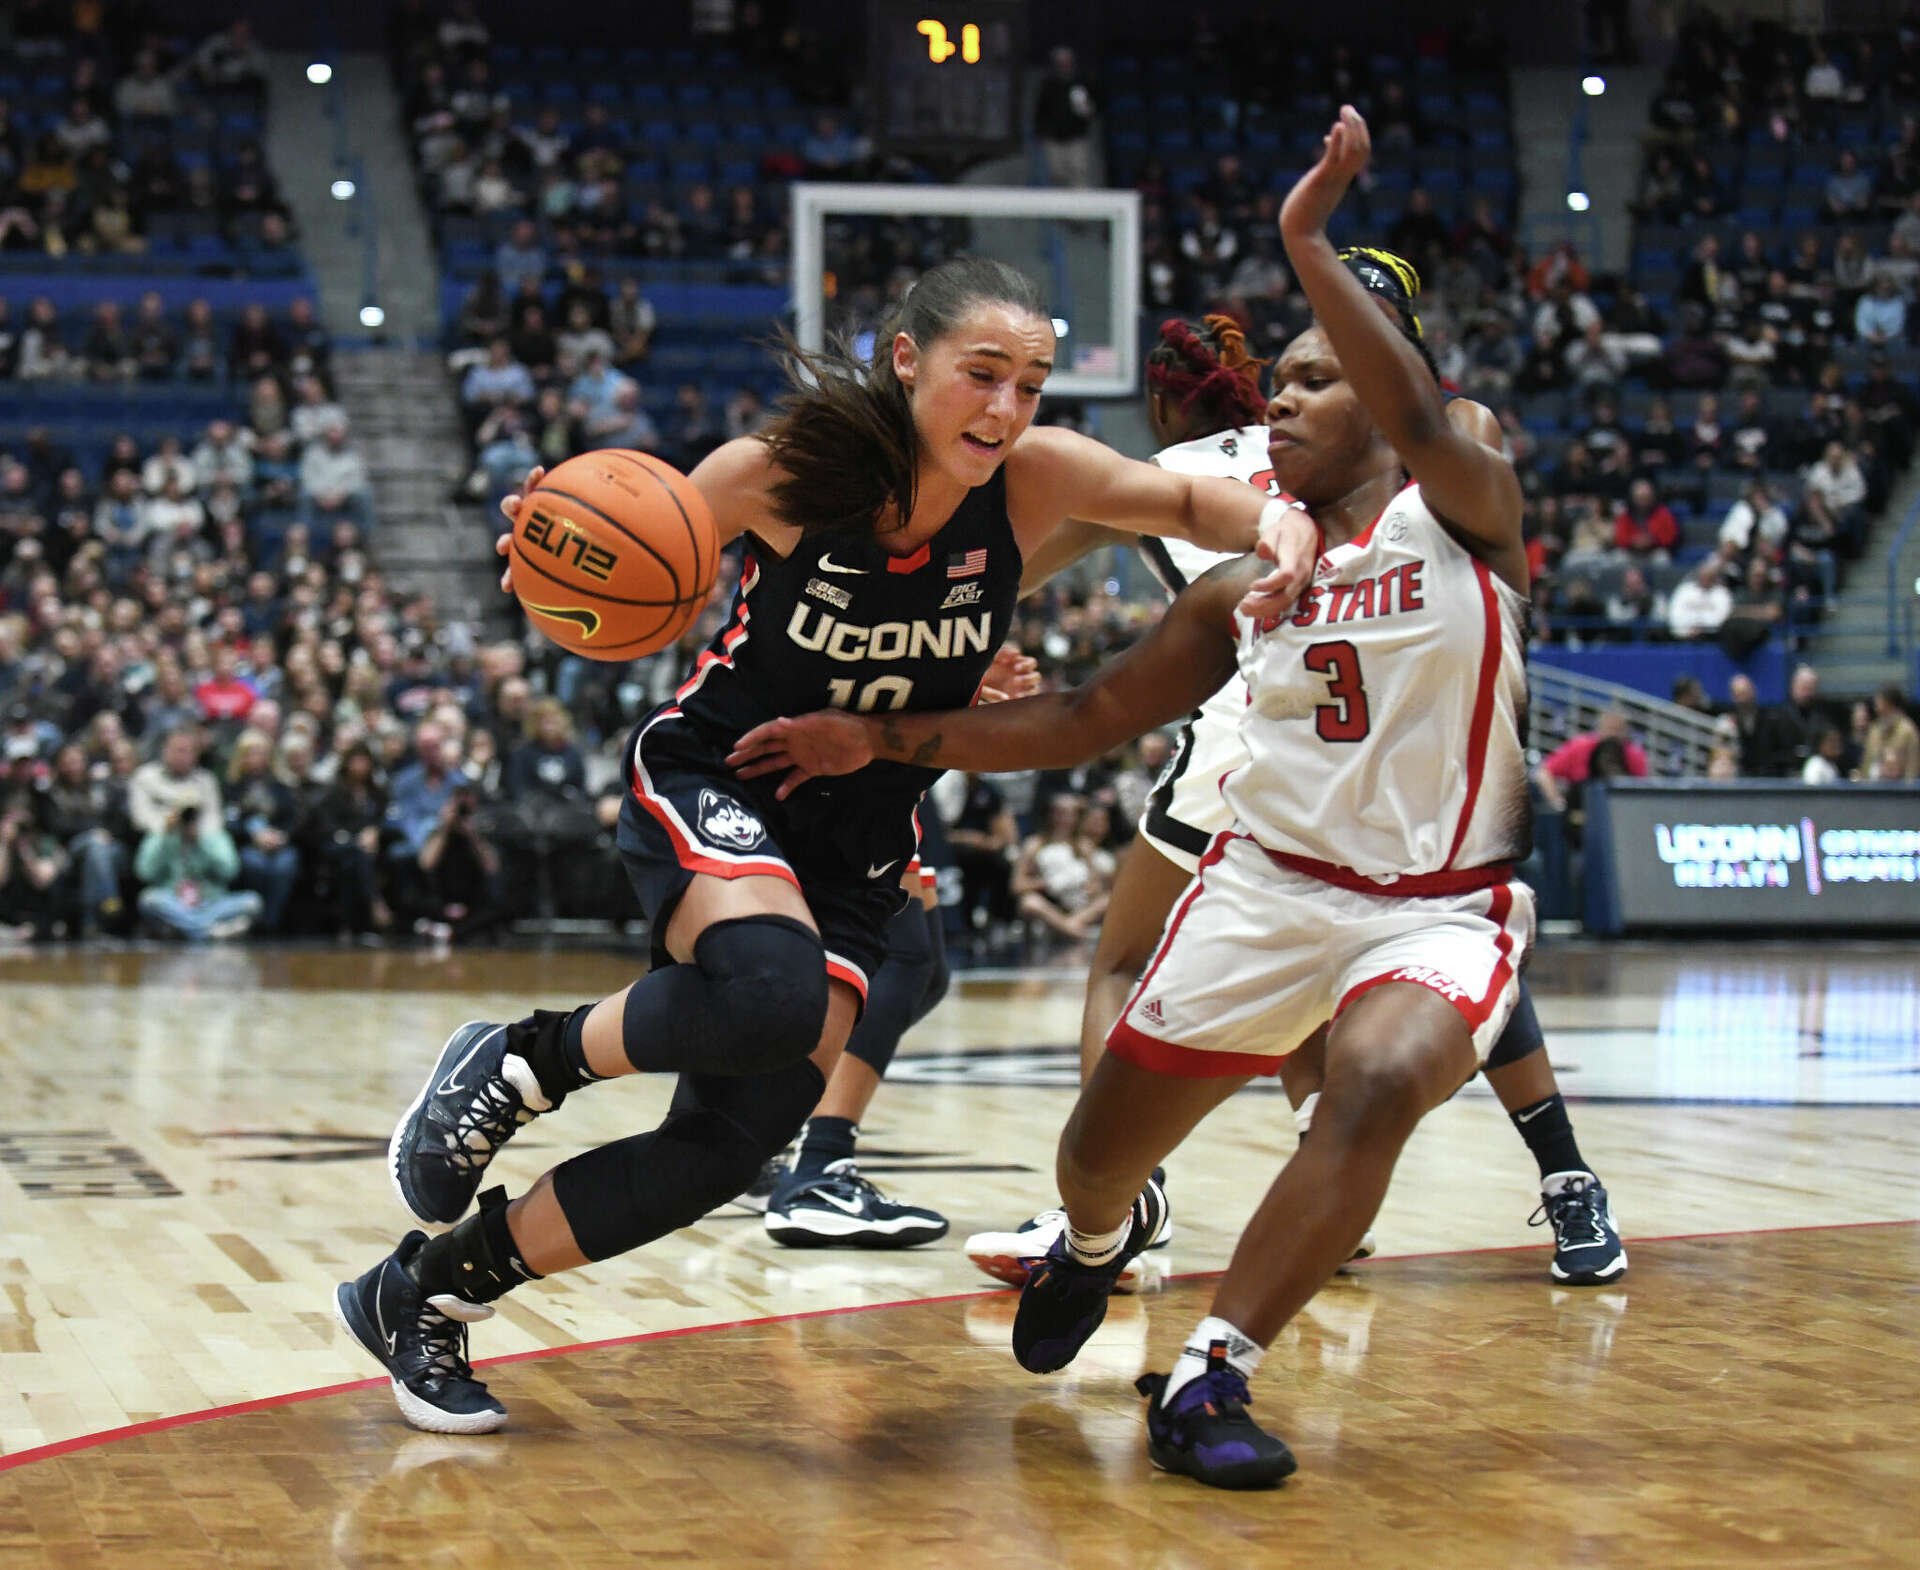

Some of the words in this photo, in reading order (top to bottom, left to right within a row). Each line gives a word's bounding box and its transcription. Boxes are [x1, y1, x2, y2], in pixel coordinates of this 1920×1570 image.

[522, 510, 618, 581] ELITE
[944, 590, 984, 605] EAST
[951, 582, 979, 596] BIG
[1292, 560, 1424, 627] STATE
[786, 601, 992, 661] UCONN
[1304, 640, 1370, 742] 3
[1654, 823, 1801, 863] UCONN
[1392, 967, 1467, 1002] PACK
